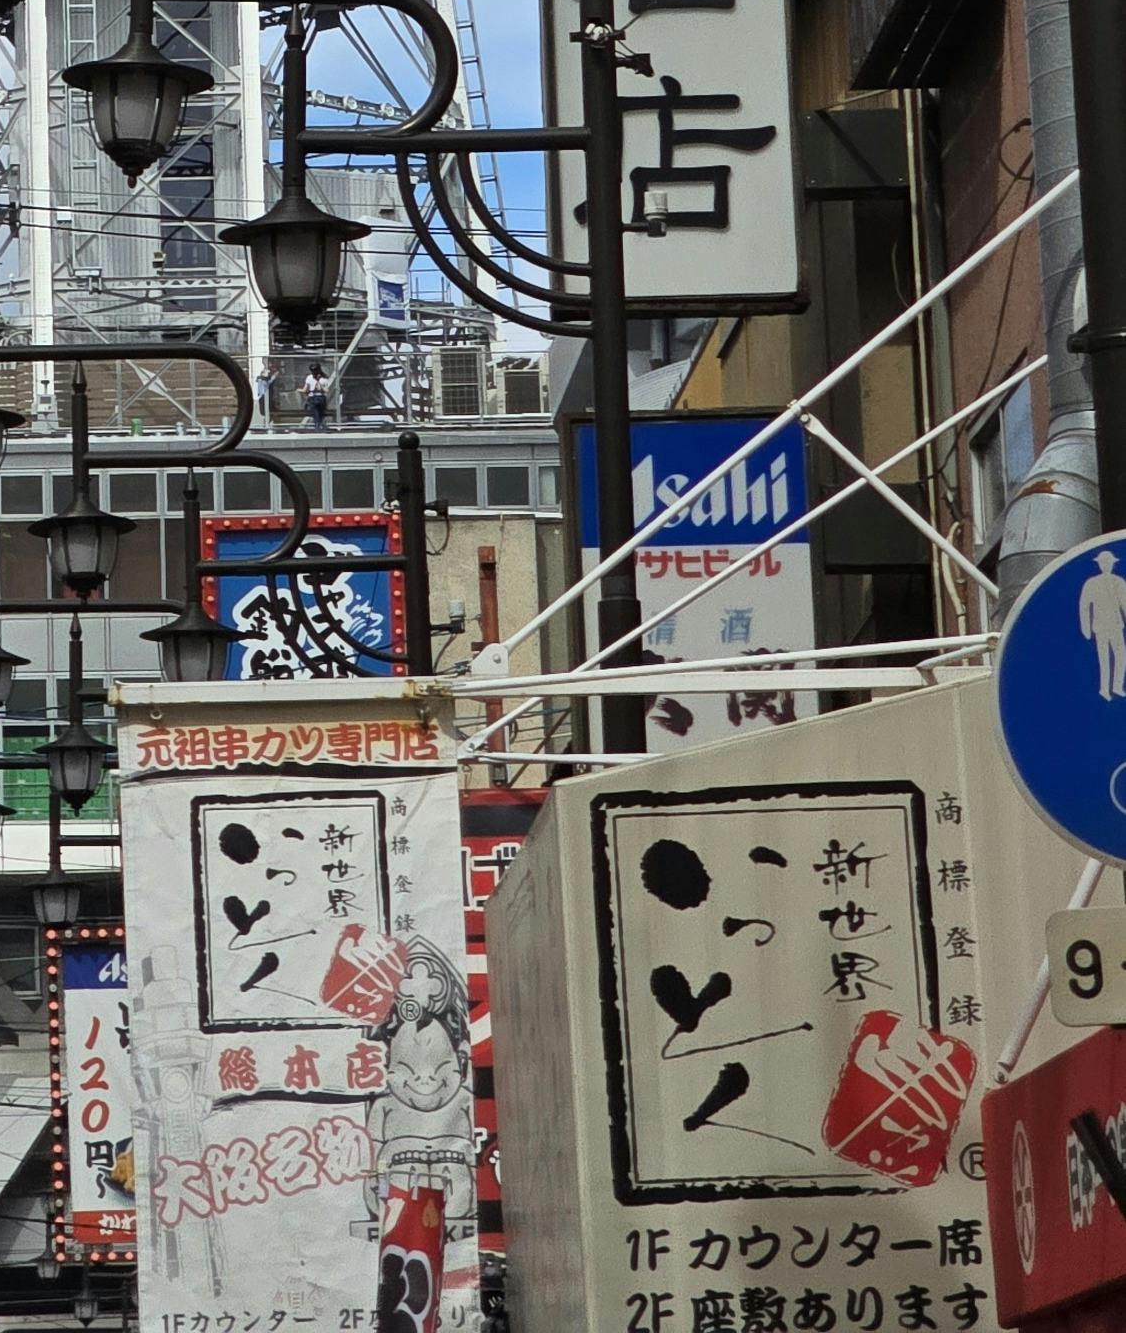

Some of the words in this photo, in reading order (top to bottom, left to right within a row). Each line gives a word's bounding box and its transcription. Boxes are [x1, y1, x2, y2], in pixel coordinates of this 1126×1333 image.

[634, 548, 782, 580] サヒビル
[136, 721, 440, 768] 元祖串カツ専門店
[318, 823, 367, 918] 新世界
[389, 796, 416, 933] 商標登録
[934, 790, 983, 1026] 商標登録
[813, 839, 894, 1003] 新世界
[218, 1043, 387, 1092] 総本店
